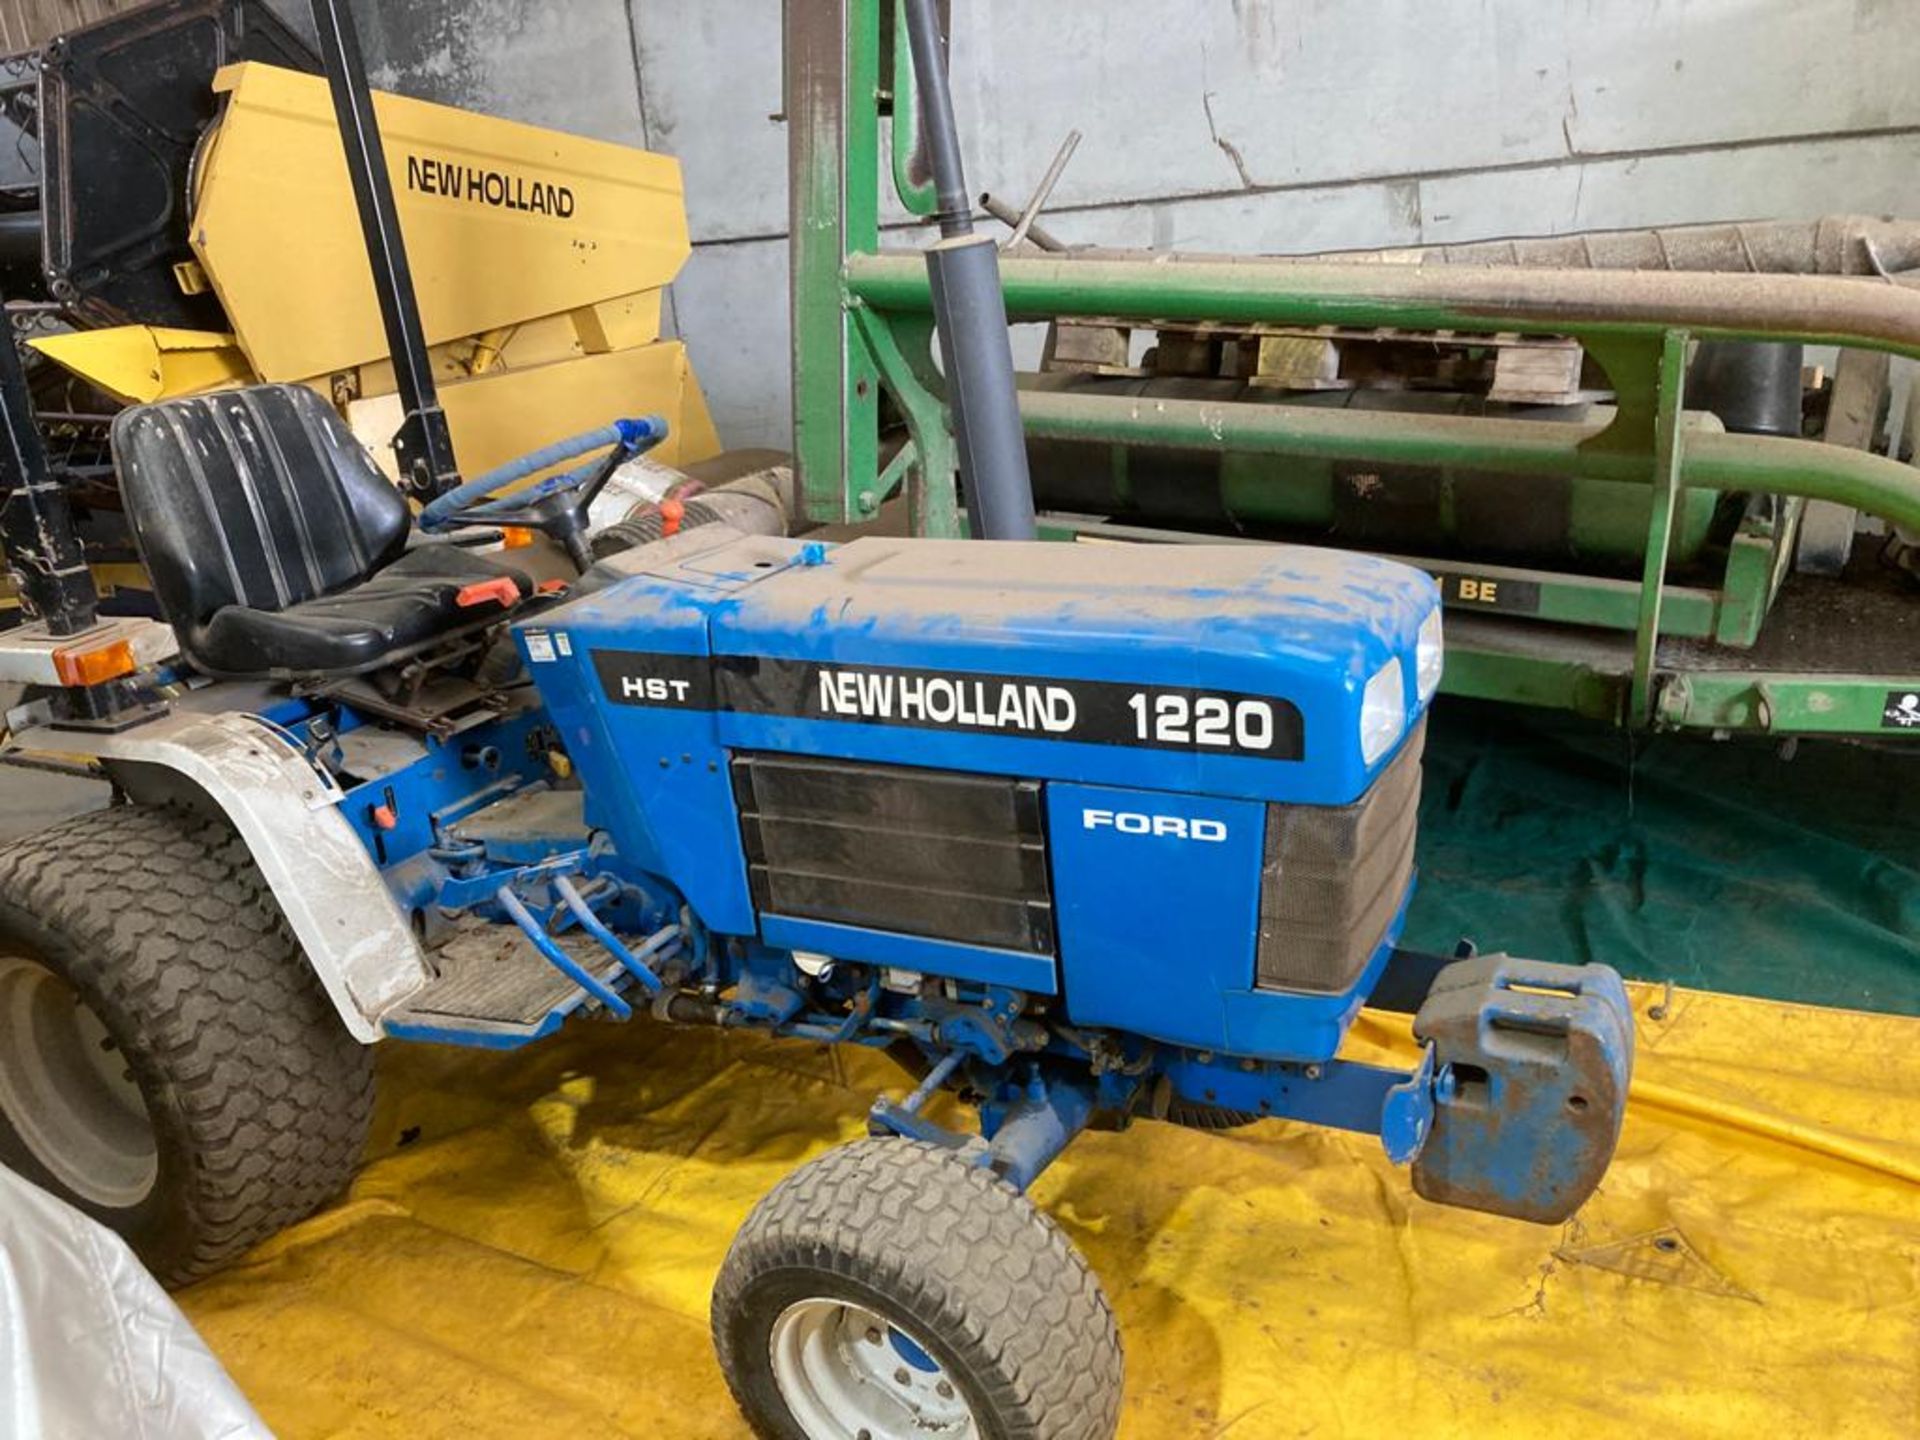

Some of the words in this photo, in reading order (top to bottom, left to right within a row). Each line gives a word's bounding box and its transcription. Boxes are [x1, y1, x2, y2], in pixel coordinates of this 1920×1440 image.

[408, 155, 462, 198] NEW
[467, 168, 574, 218] HOLLAND
[1459, 579, 1497, 602] BE
[622, 676, 690, 701] HST
[818, 670, 893, 717] NEW
[899, 676, 1077, 732] HOLLAND
[1128, 693, 1273, 749] 1220
[1082, 809, 1227, 842] FORD
